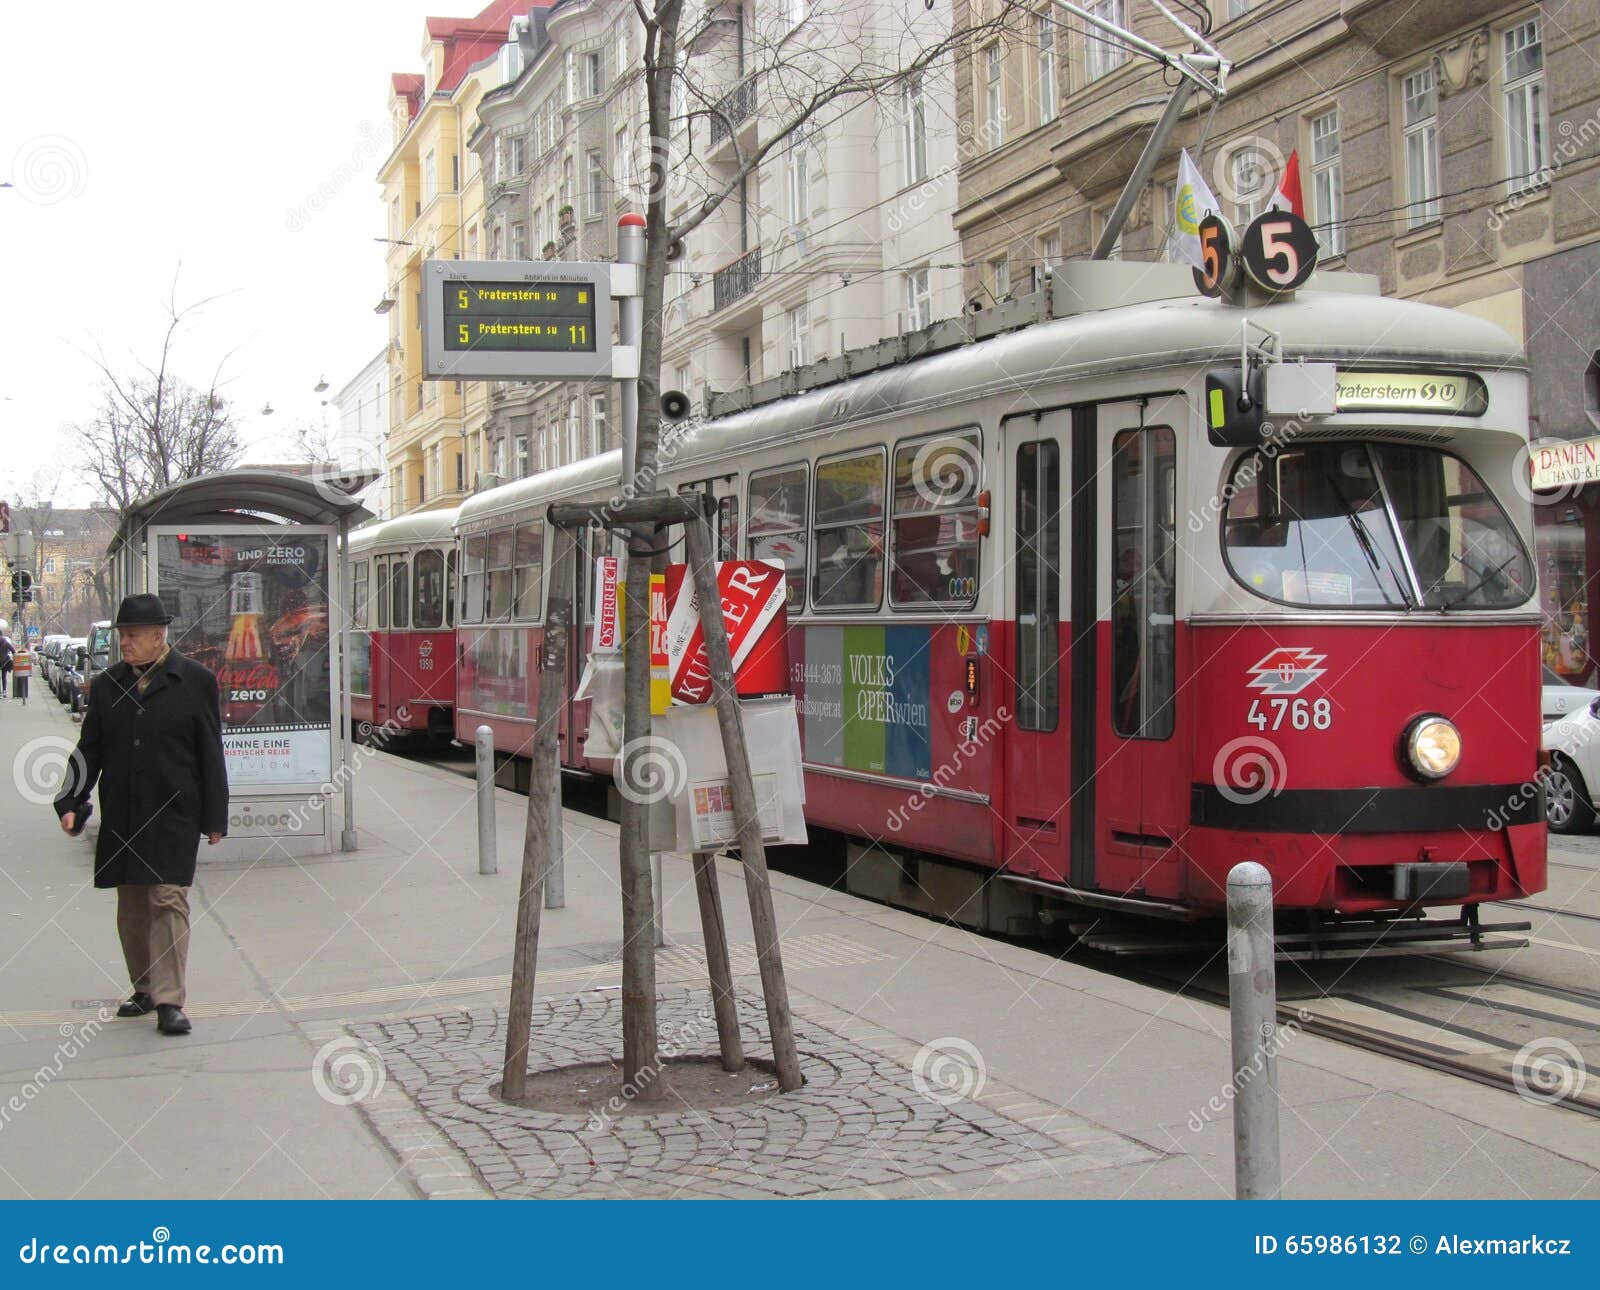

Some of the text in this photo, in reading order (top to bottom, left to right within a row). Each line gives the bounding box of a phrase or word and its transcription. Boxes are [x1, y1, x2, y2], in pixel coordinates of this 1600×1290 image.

[1202, 226, 1219, 289] 5
[1261, 221, 1298, 285] 5
[458, 289, 468, 309] 5
[478, 289, 540, 301] Praterstern
[459, 324, 469, 344] 5
[479, 323, 541, 335] Praterstern
[569, 325, 586, 345] 11
[237, 550, 262, 561] UND
[267, 547, 305, 559] ZERO
[600, 557, 617, 647] ÖSTERREICH
[678, 566, 770, 700] KUER
[849, 654, 894, 687] VOLKS
[231, 689, 266, 701] zero
[1247, 698, 1332, 731] 4768
[263, 739, 290, 748] EINE
